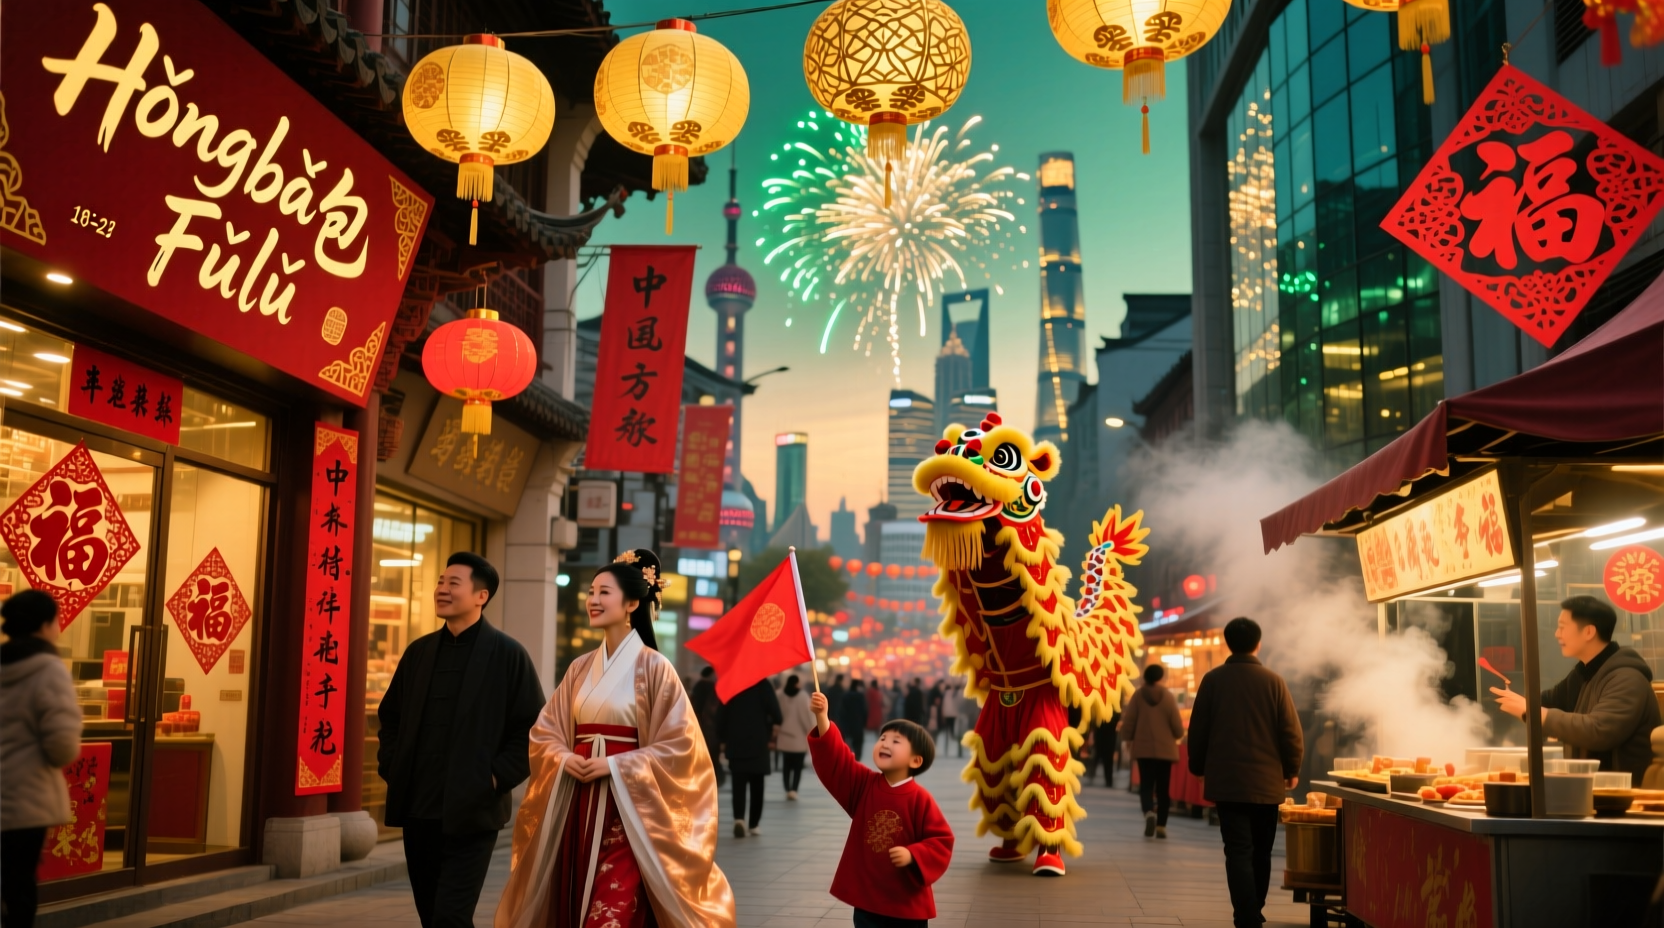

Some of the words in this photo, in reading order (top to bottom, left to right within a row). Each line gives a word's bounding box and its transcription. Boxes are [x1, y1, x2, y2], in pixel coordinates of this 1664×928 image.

[1460, 130, 1606, 270] 福
[30, 480, 109, 586] 福
[187, 578, 233, 641] 福
